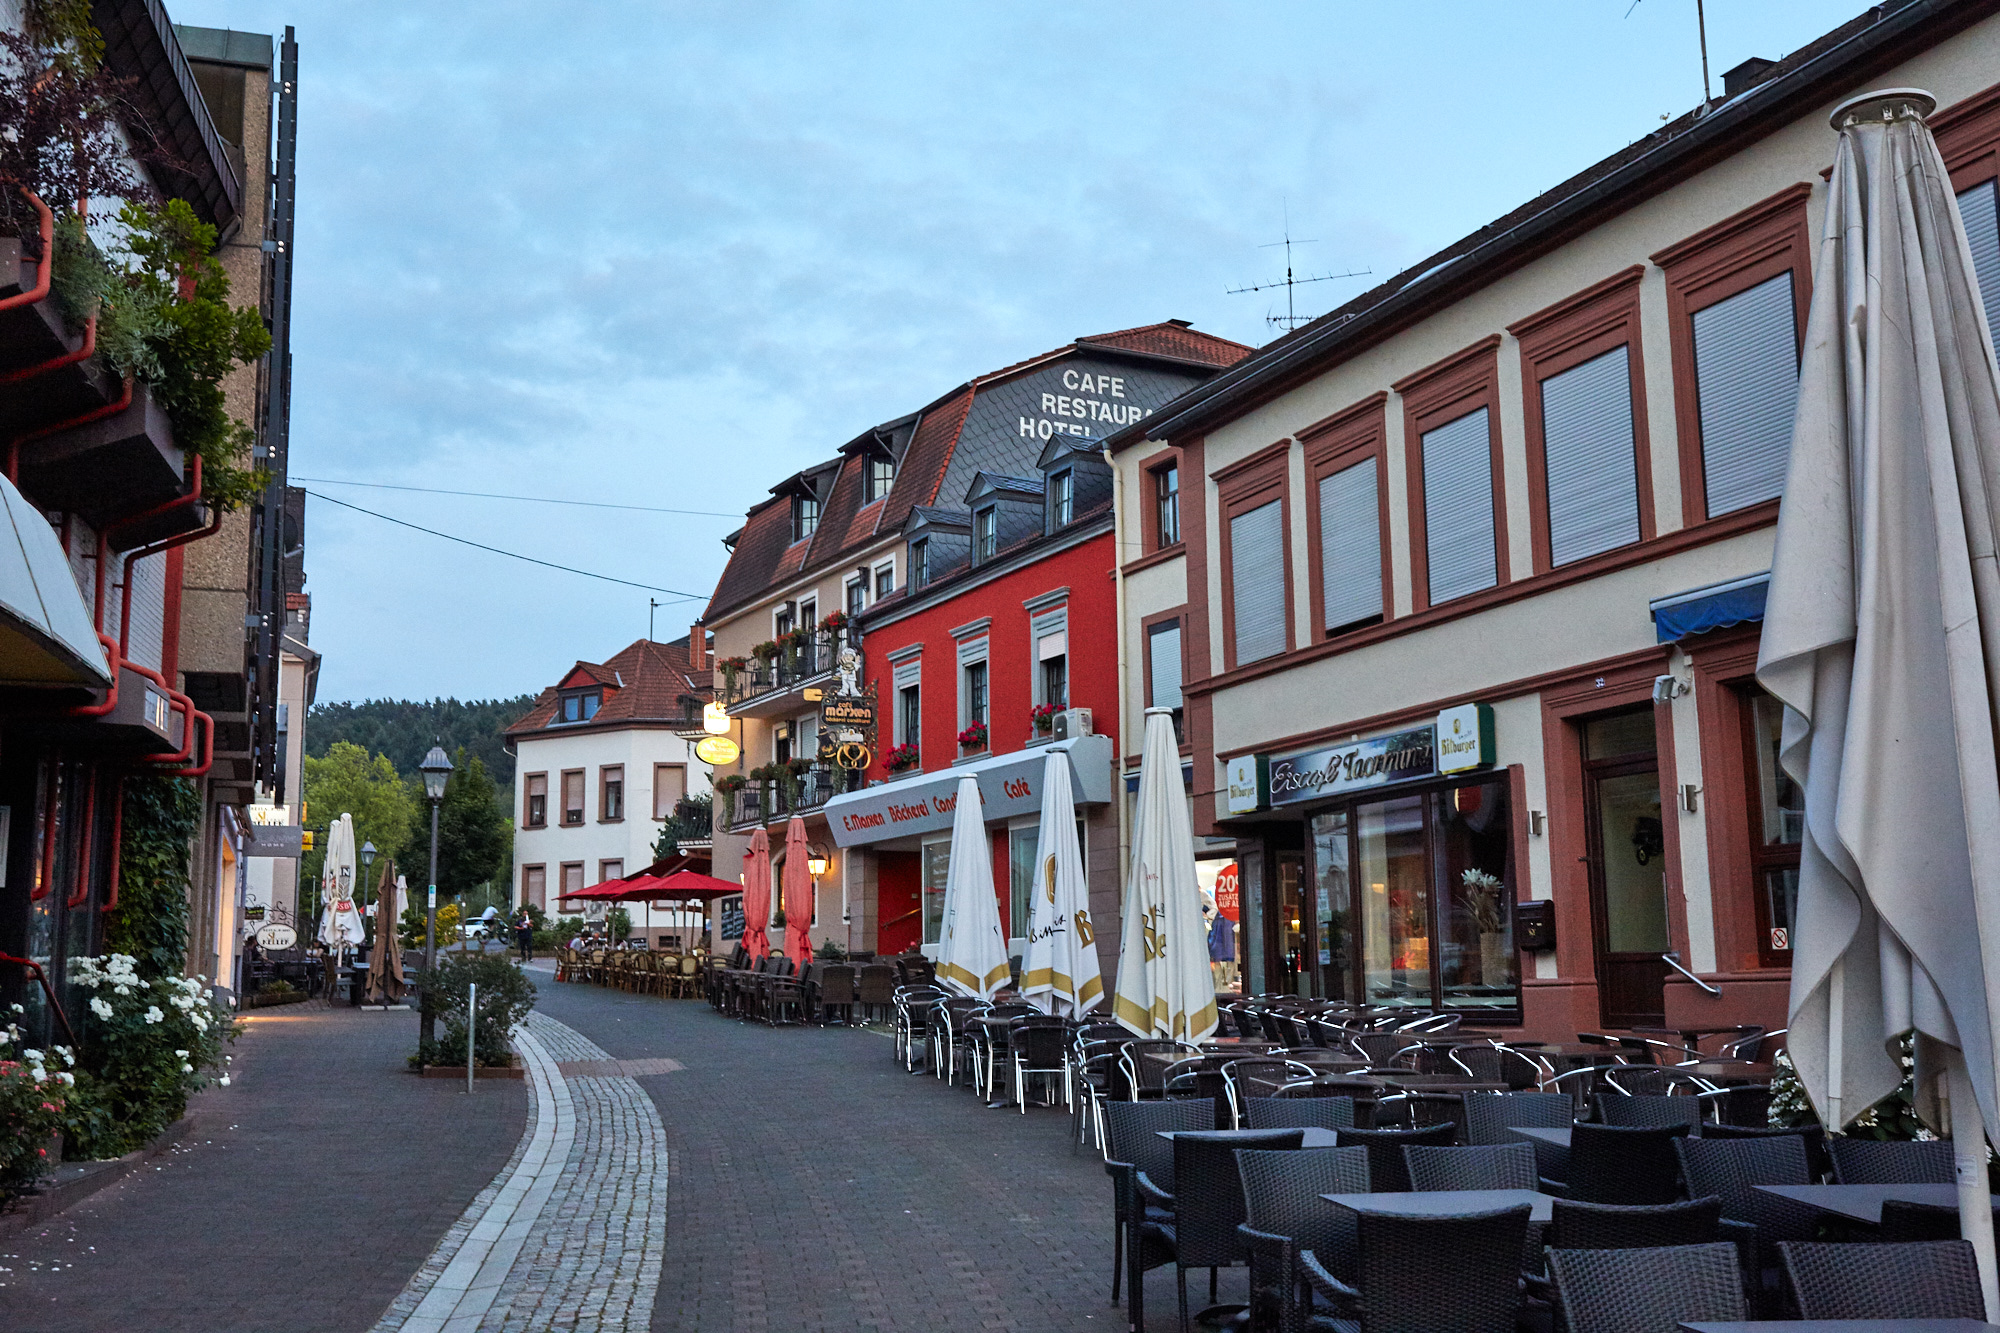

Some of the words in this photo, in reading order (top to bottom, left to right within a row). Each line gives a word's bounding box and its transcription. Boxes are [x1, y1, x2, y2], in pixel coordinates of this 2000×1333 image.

[1063, 369, 1125, 398] CAFE
[825, 706, 871, 718] marxen
[888, 799, 930, 823] Bäckerei
[1003, 776, 1031, 799] Café
